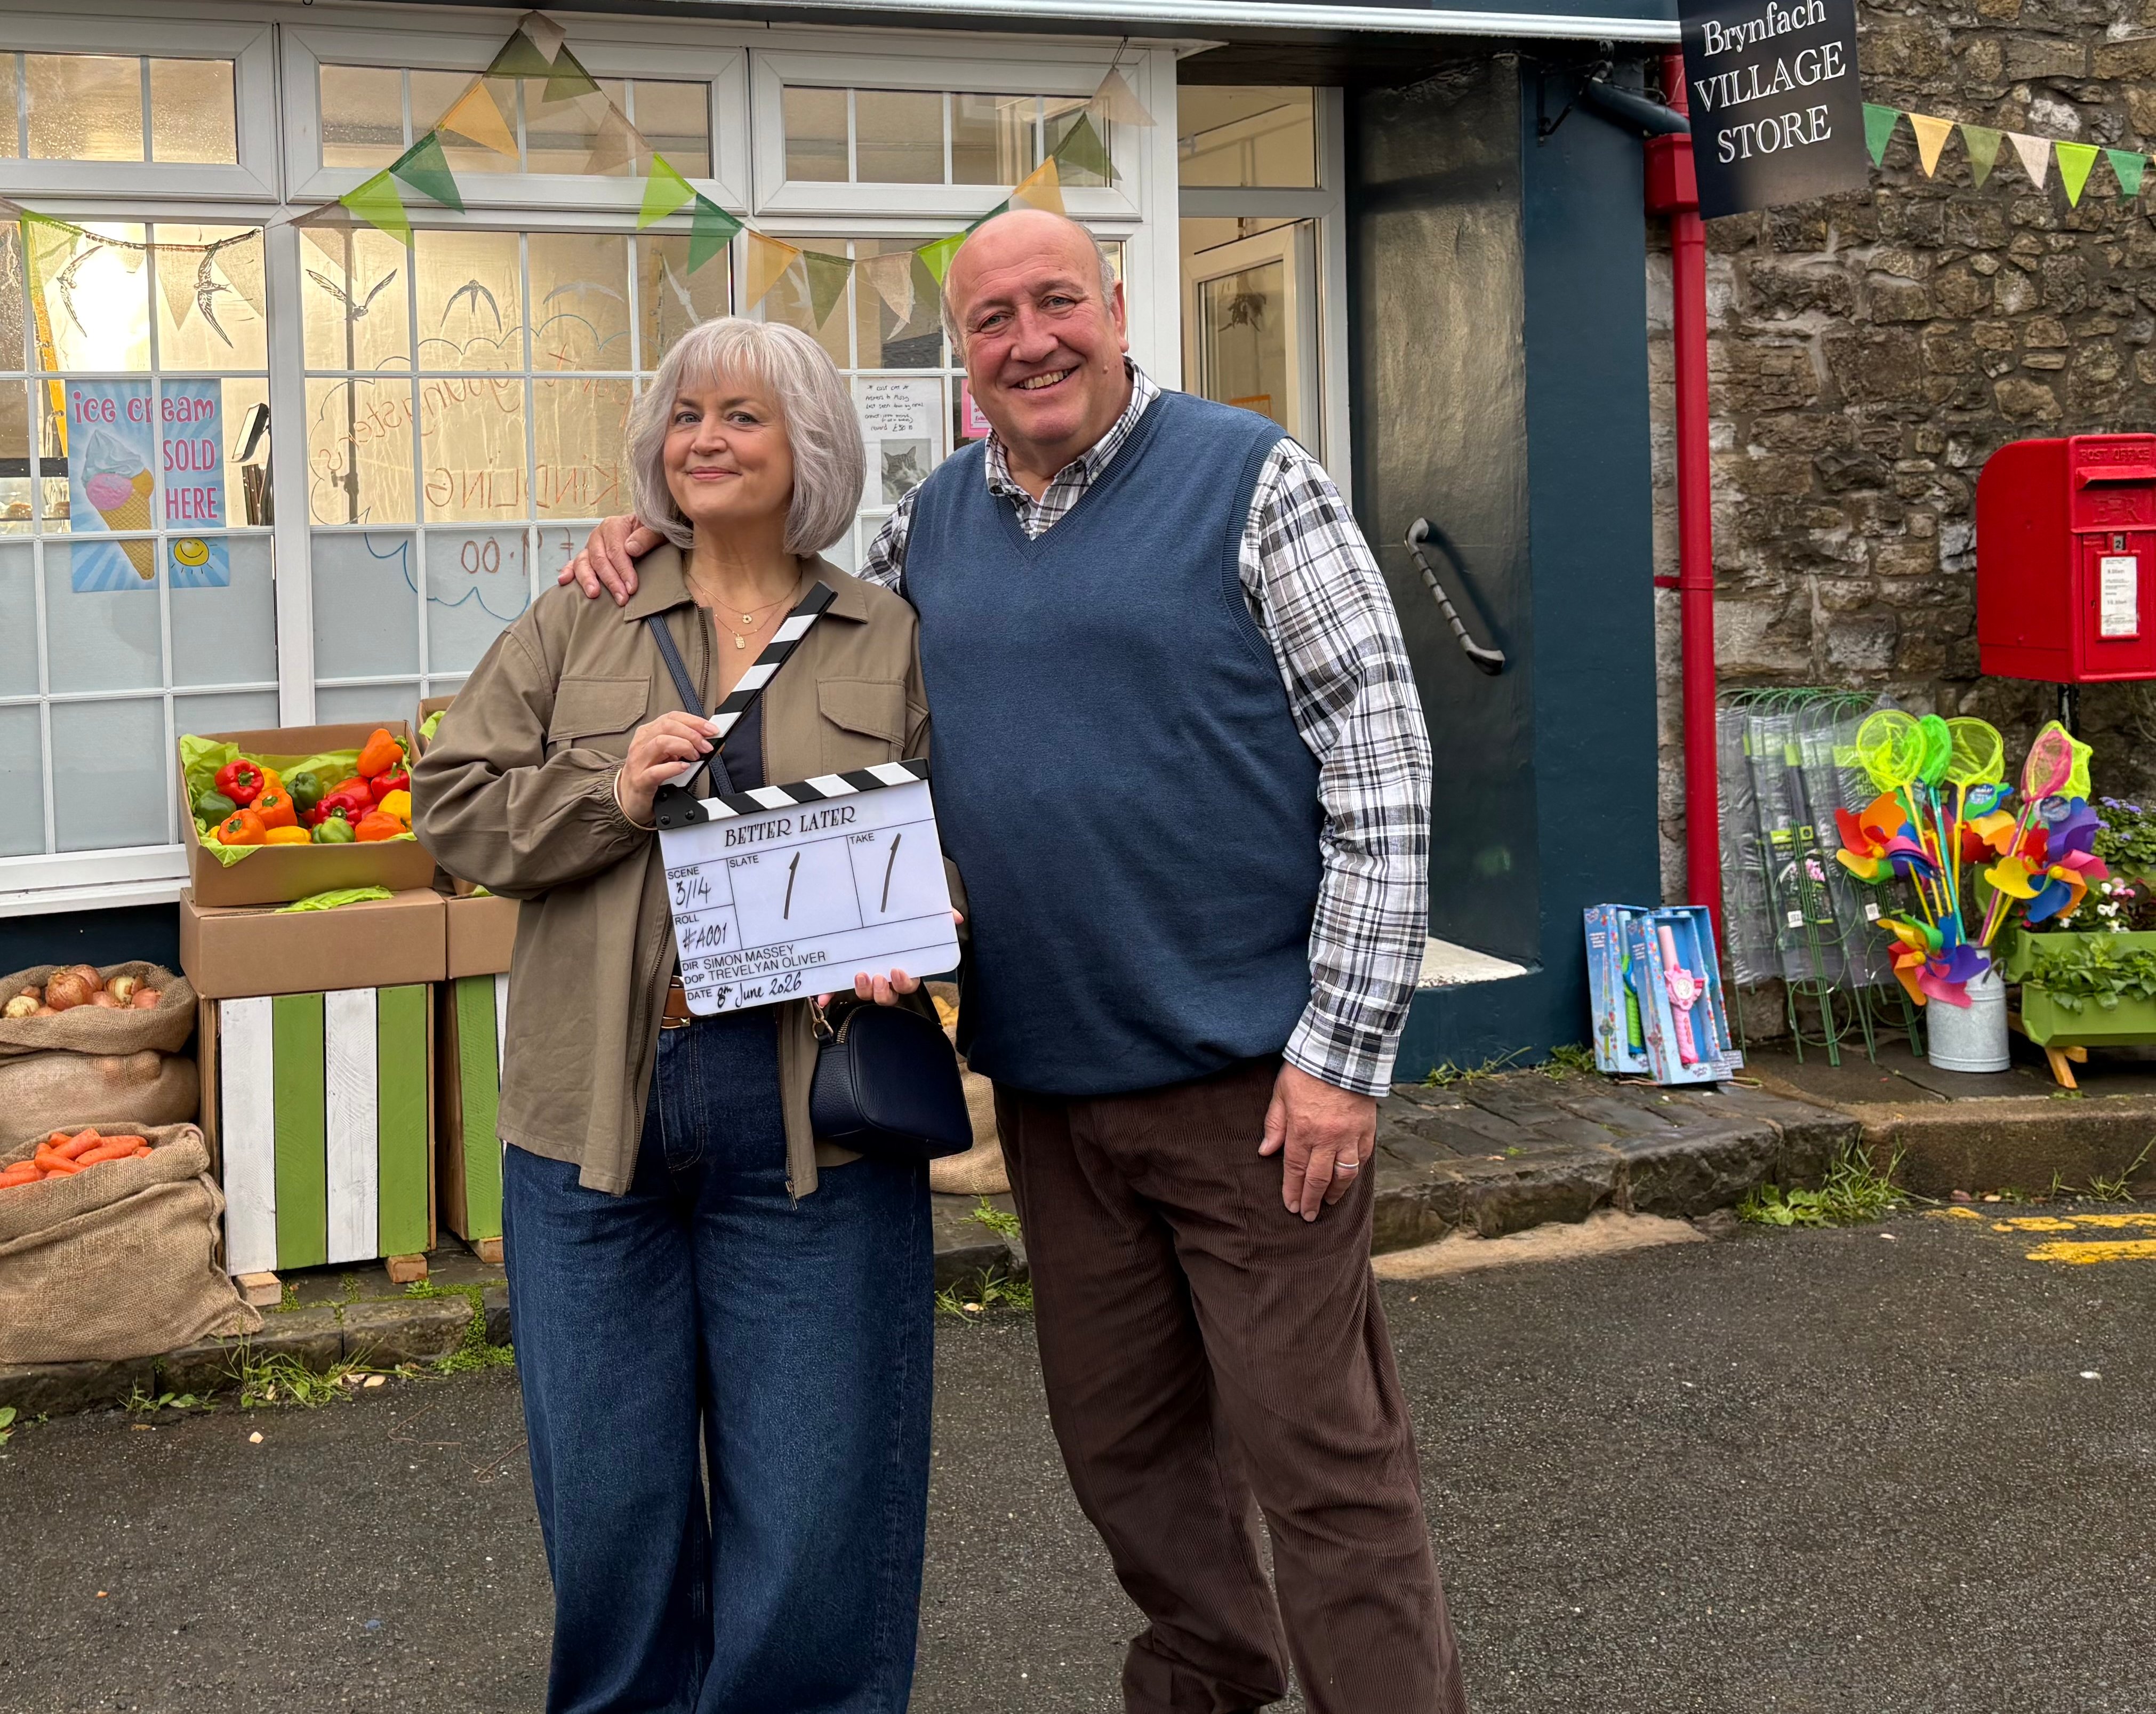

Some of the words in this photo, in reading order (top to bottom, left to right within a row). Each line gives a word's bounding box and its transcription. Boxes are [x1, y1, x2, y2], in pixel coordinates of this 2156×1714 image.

[1701, 0, 1826, 57] Brynfach
[1694, 41, 1846, 113] VILLAGE
[1718, 105, 1831, 163] STORE
[73, 391, 116, 423] ice
[127, 396, 214, 423] cream
[163, 439, 215, 471] SOLD
[2079, 448, 2107, 461] POST
[2113, 446, 2150, 461] OFFICE
[166, 487, 218, 519] HERE
[2115, 540, 2121, 549] 2
[724, 818, 792, 847] BETTER
[799, 806, 857, 833] LATER
[849, 832, 875, 845] TAKE
[668, 867, 700, 879] SCENE
[729, 855, 759, 868] SLATE
[880, 832, 902, 913] 1
[676, 876, 711, 909] 3/14
[783, 851, 800, 920] 1
[675, 914, 700, 925] ROLL
[683, 922, 727, 953] #A001
[682, 962, 699, 971] DIR
[703, 953, 742, 970] SIMON
[746, 944, 794, 962] MASSEY
[684, 973, 705, 985] DOP
[709, 959, 779, 981] TREVELYAN
[782, 951, 826, 968] OLIVER
[687, 988, 712, 1001] DATE
[735, 982, 764, 1008] June
[768, 970, 802, 996] 2026
